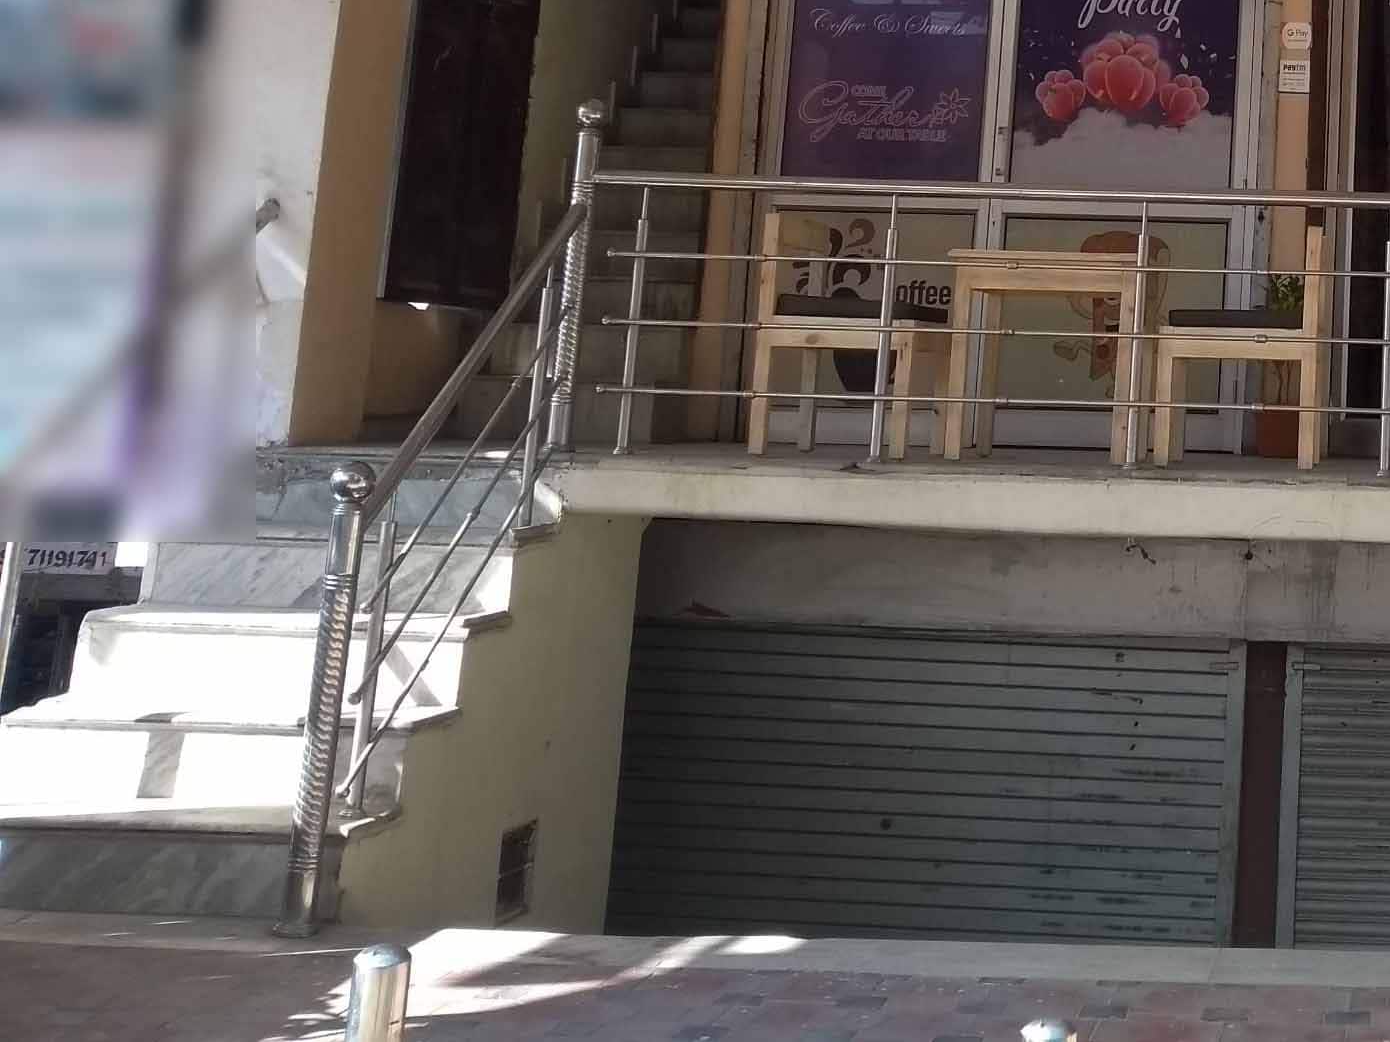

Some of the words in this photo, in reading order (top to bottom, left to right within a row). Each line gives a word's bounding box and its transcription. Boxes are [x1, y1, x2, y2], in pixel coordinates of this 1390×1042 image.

[809, 8, 866, 39] Coffee
[904, 13, 967, 38] Sweets
[894, 279, 950, 305] offee
